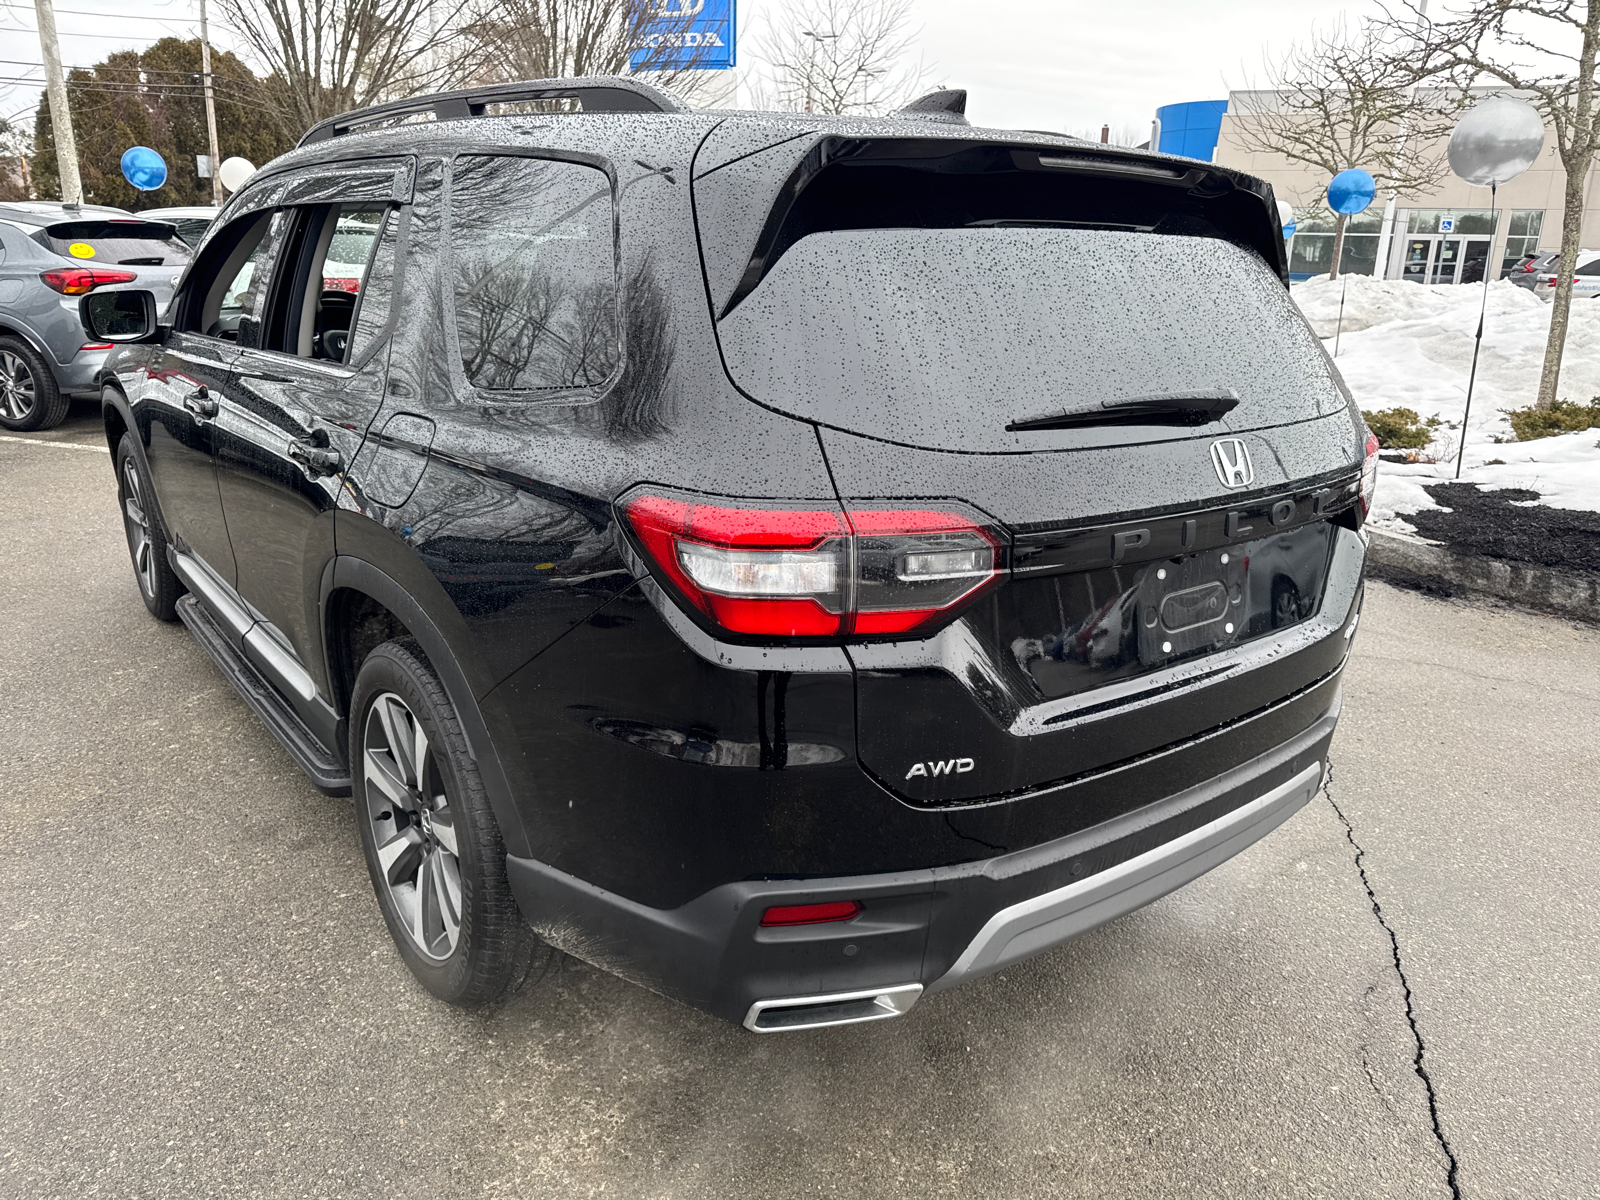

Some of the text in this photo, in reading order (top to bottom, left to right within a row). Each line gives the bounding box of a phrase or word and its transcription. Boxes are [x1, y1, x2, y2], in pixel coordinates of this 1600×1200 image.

[1111, 487, 1331, 565] PILOT
[396, 673, 437, 742] ALENZA
[905, 757, 975, 780] AWD
